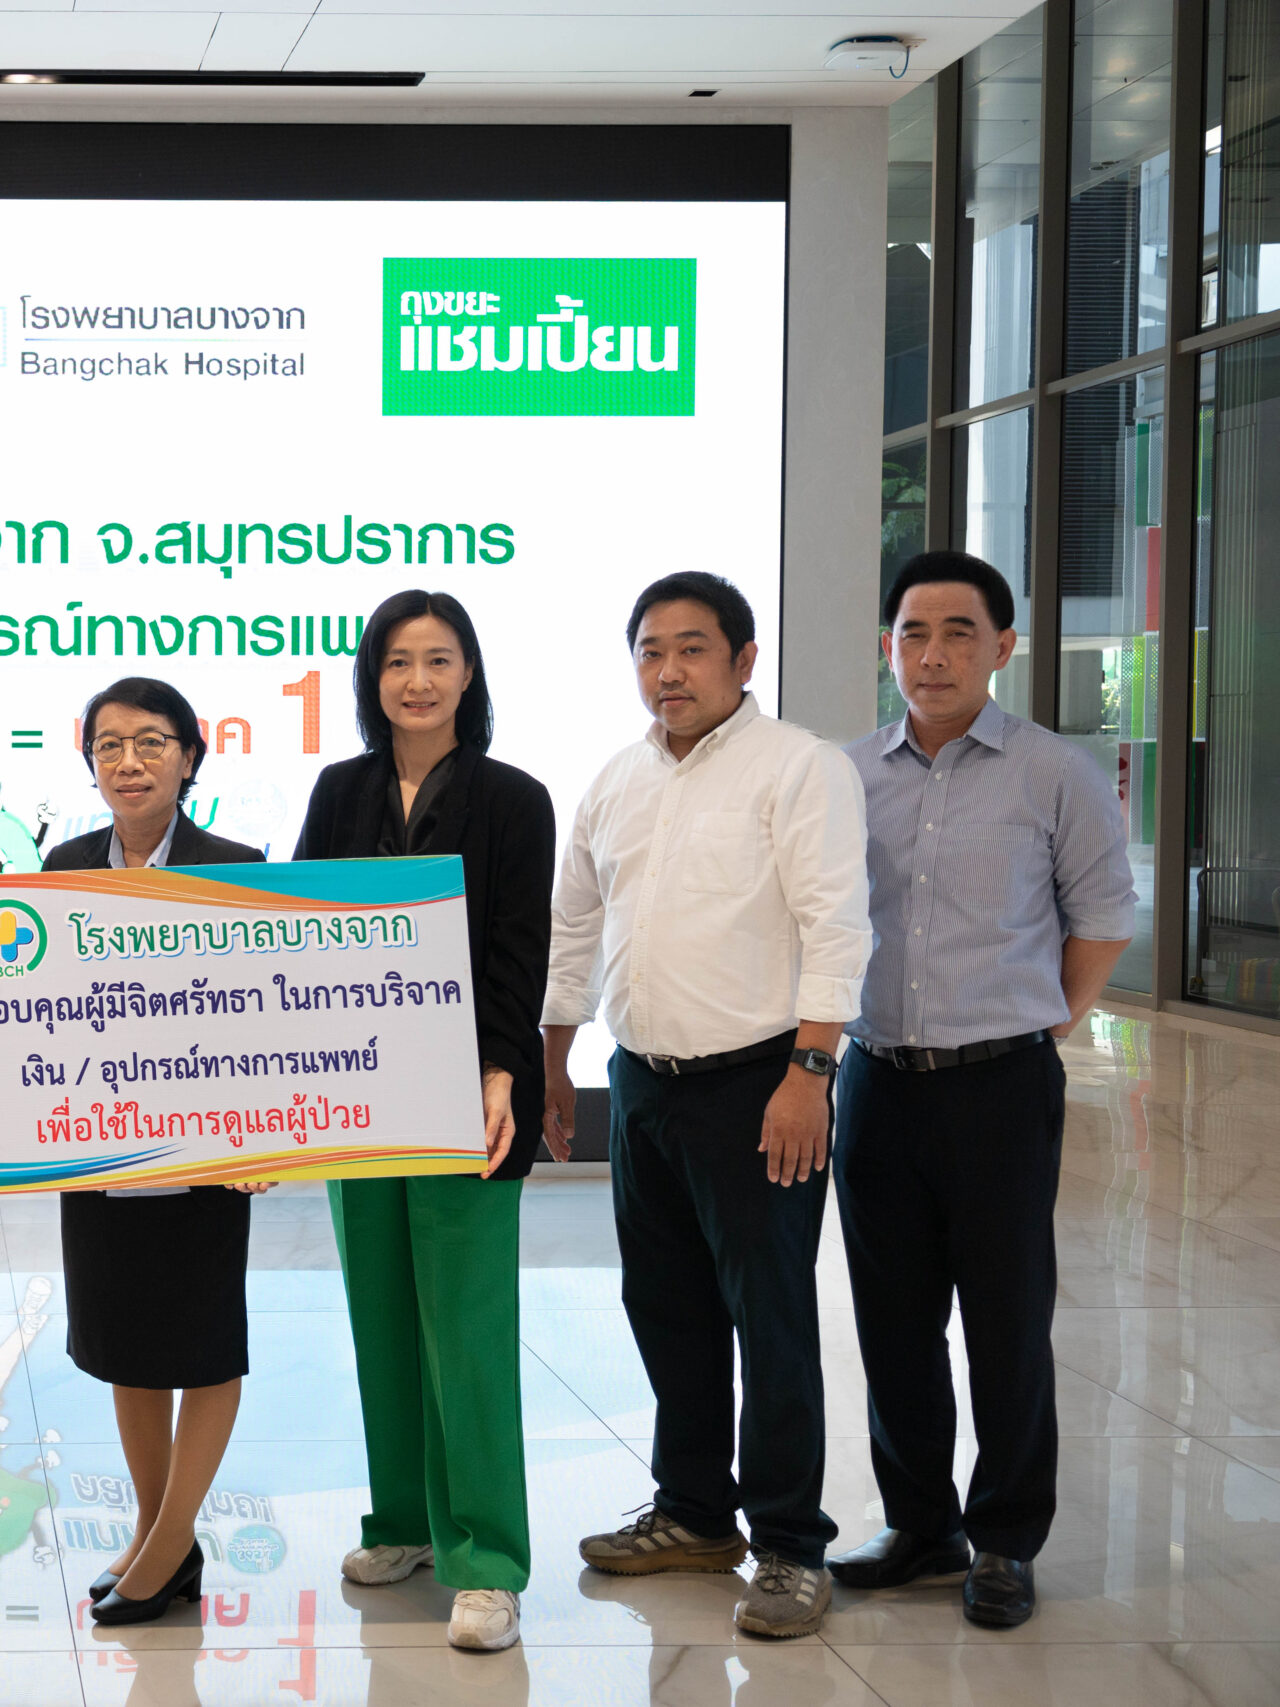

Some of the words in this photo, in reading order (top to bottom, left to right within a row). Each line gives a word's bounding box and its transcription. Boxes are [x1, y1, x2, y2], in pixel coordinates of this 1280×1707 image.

[19, 295, 306, 330] โรงพยาบาลบางจาก
[400, 290, 500, 321] ถุงขยะ
[400, 294, 679, 373] แชมเปี้ยน
[20, 351, 169, 382] Bangchak
[184, 351, 304, 381] Hospital
[95, 514, 516, 580] จ.สมุทรปราการ
[282, 670, 322, 754] 1
[69, 910, 414, 957] โรงพยาบาลบางจาก
[272, 970, 463, 1012] ในการบริจาค
[21, 1053, 66, 1087] เงิน
[74, 1056, 91, 1086] /
[100, 1035, 379, 1094] อุปกรณ์ทางการแพทย์
[36, 1092, 372, 1148] เพื่อใช้ในการดูแลผู้ป่วย
